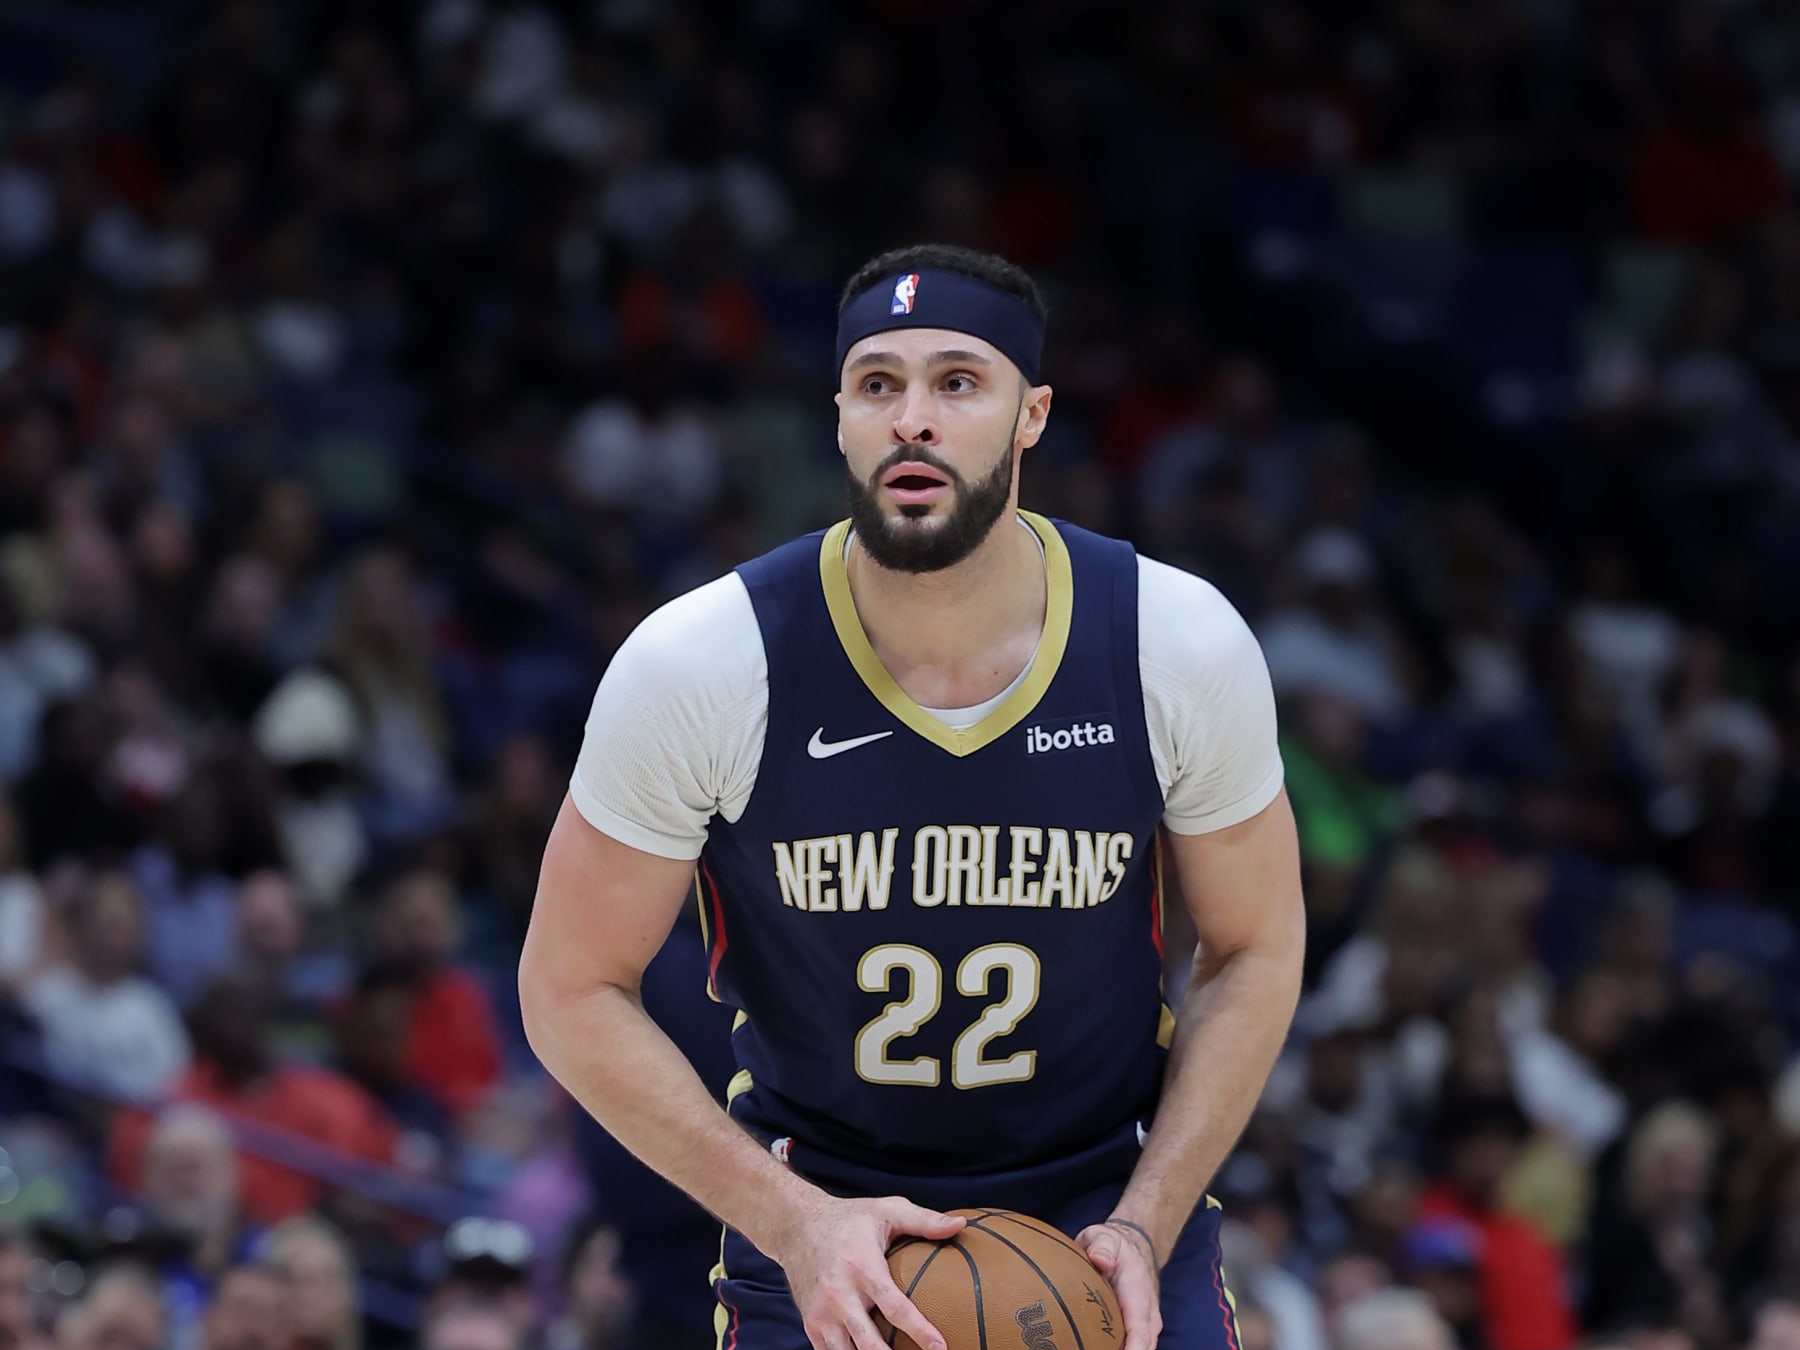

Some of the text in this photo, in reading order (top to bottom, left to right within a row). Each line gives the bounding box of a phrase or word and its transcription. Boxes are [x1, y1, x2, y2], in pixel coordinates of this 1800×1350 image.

[1026, 722, 1115, 754] ibotta
[772, 825, 1134, 912] NEW ORLEANS
[854, 942, 1041, 1090] 22
